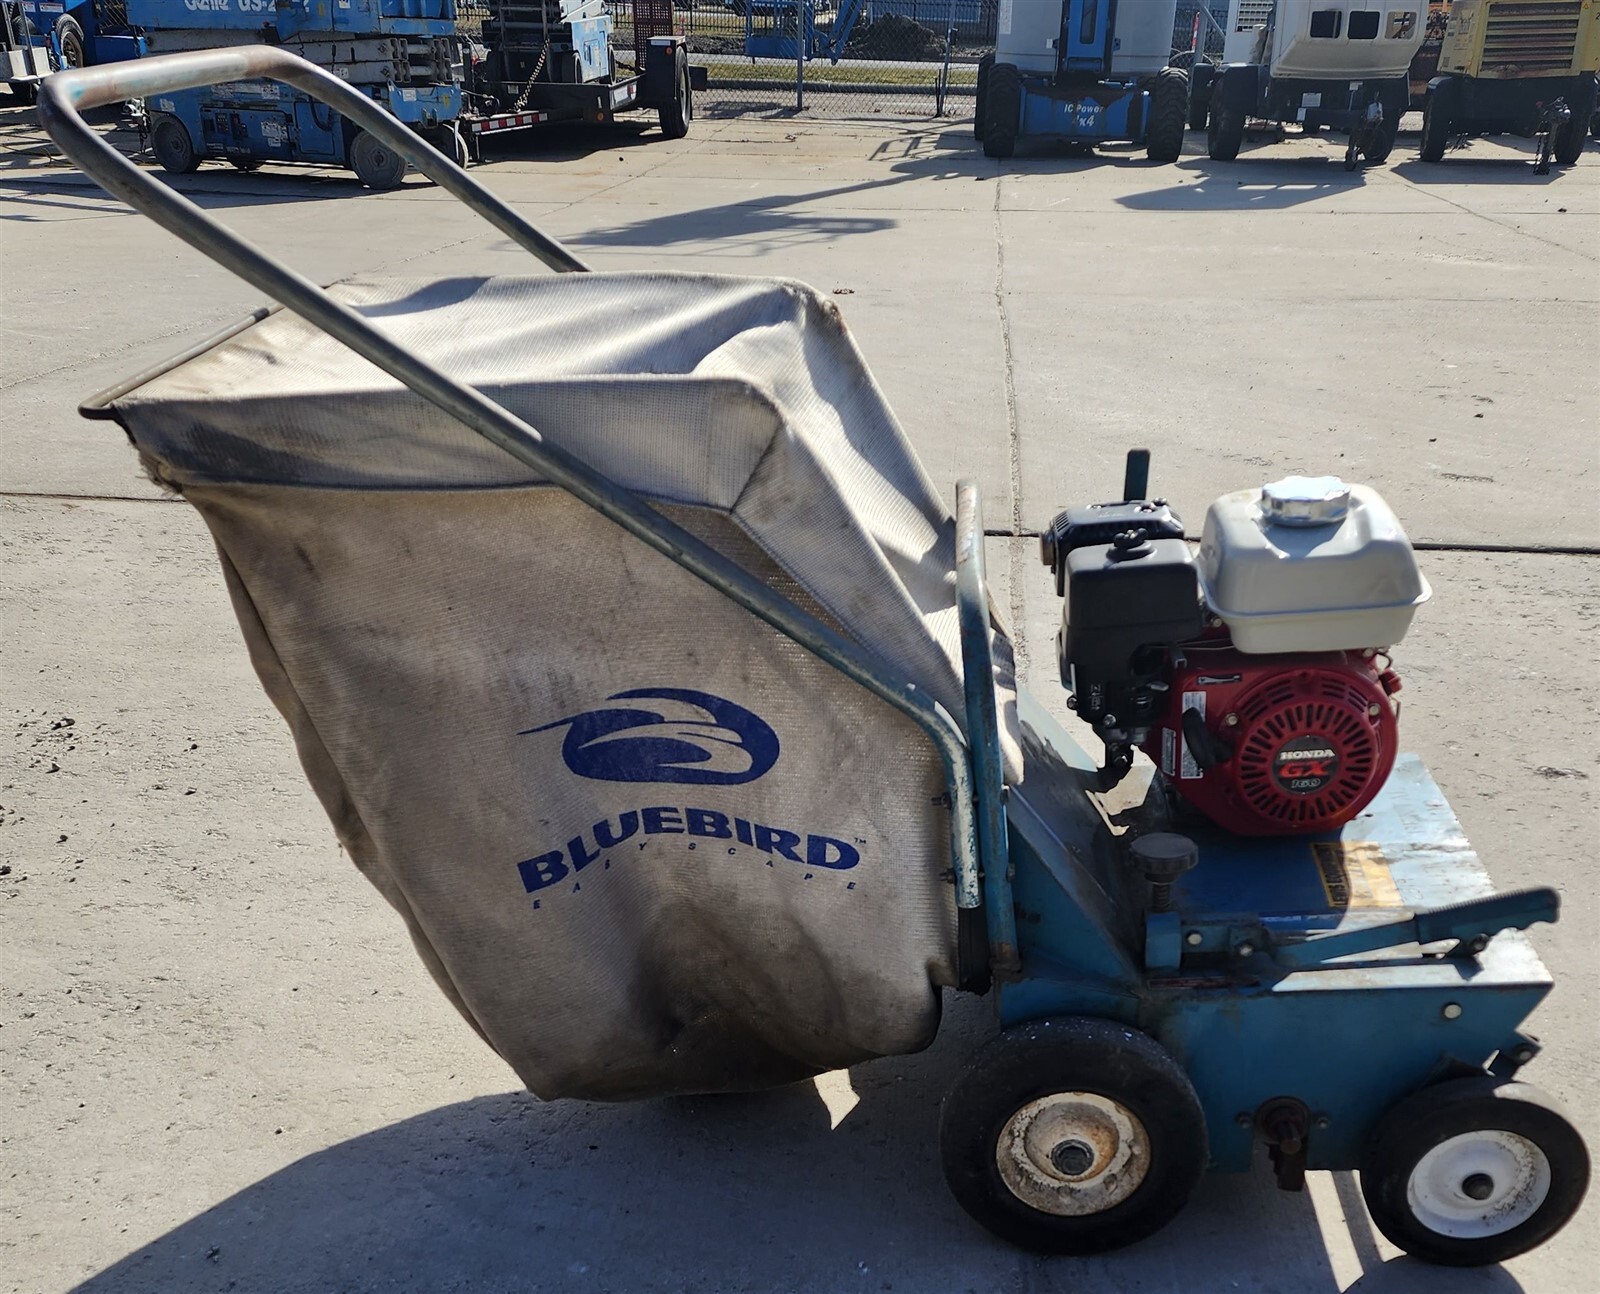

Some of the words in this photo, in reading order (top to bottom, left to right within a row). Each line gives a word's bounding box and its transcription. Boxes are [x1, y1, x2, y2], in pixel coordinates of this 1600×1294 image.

[1064, 103, 1074, 113] IC
[1076, 103, 1104, 113] Power
[1280, 749, 1336, 760] HONDA
[1279, 760, 1332, 778] GX
[1291, 778, 1321, 789] 160
[517, 806, 861, 893] BLUEBIRD
